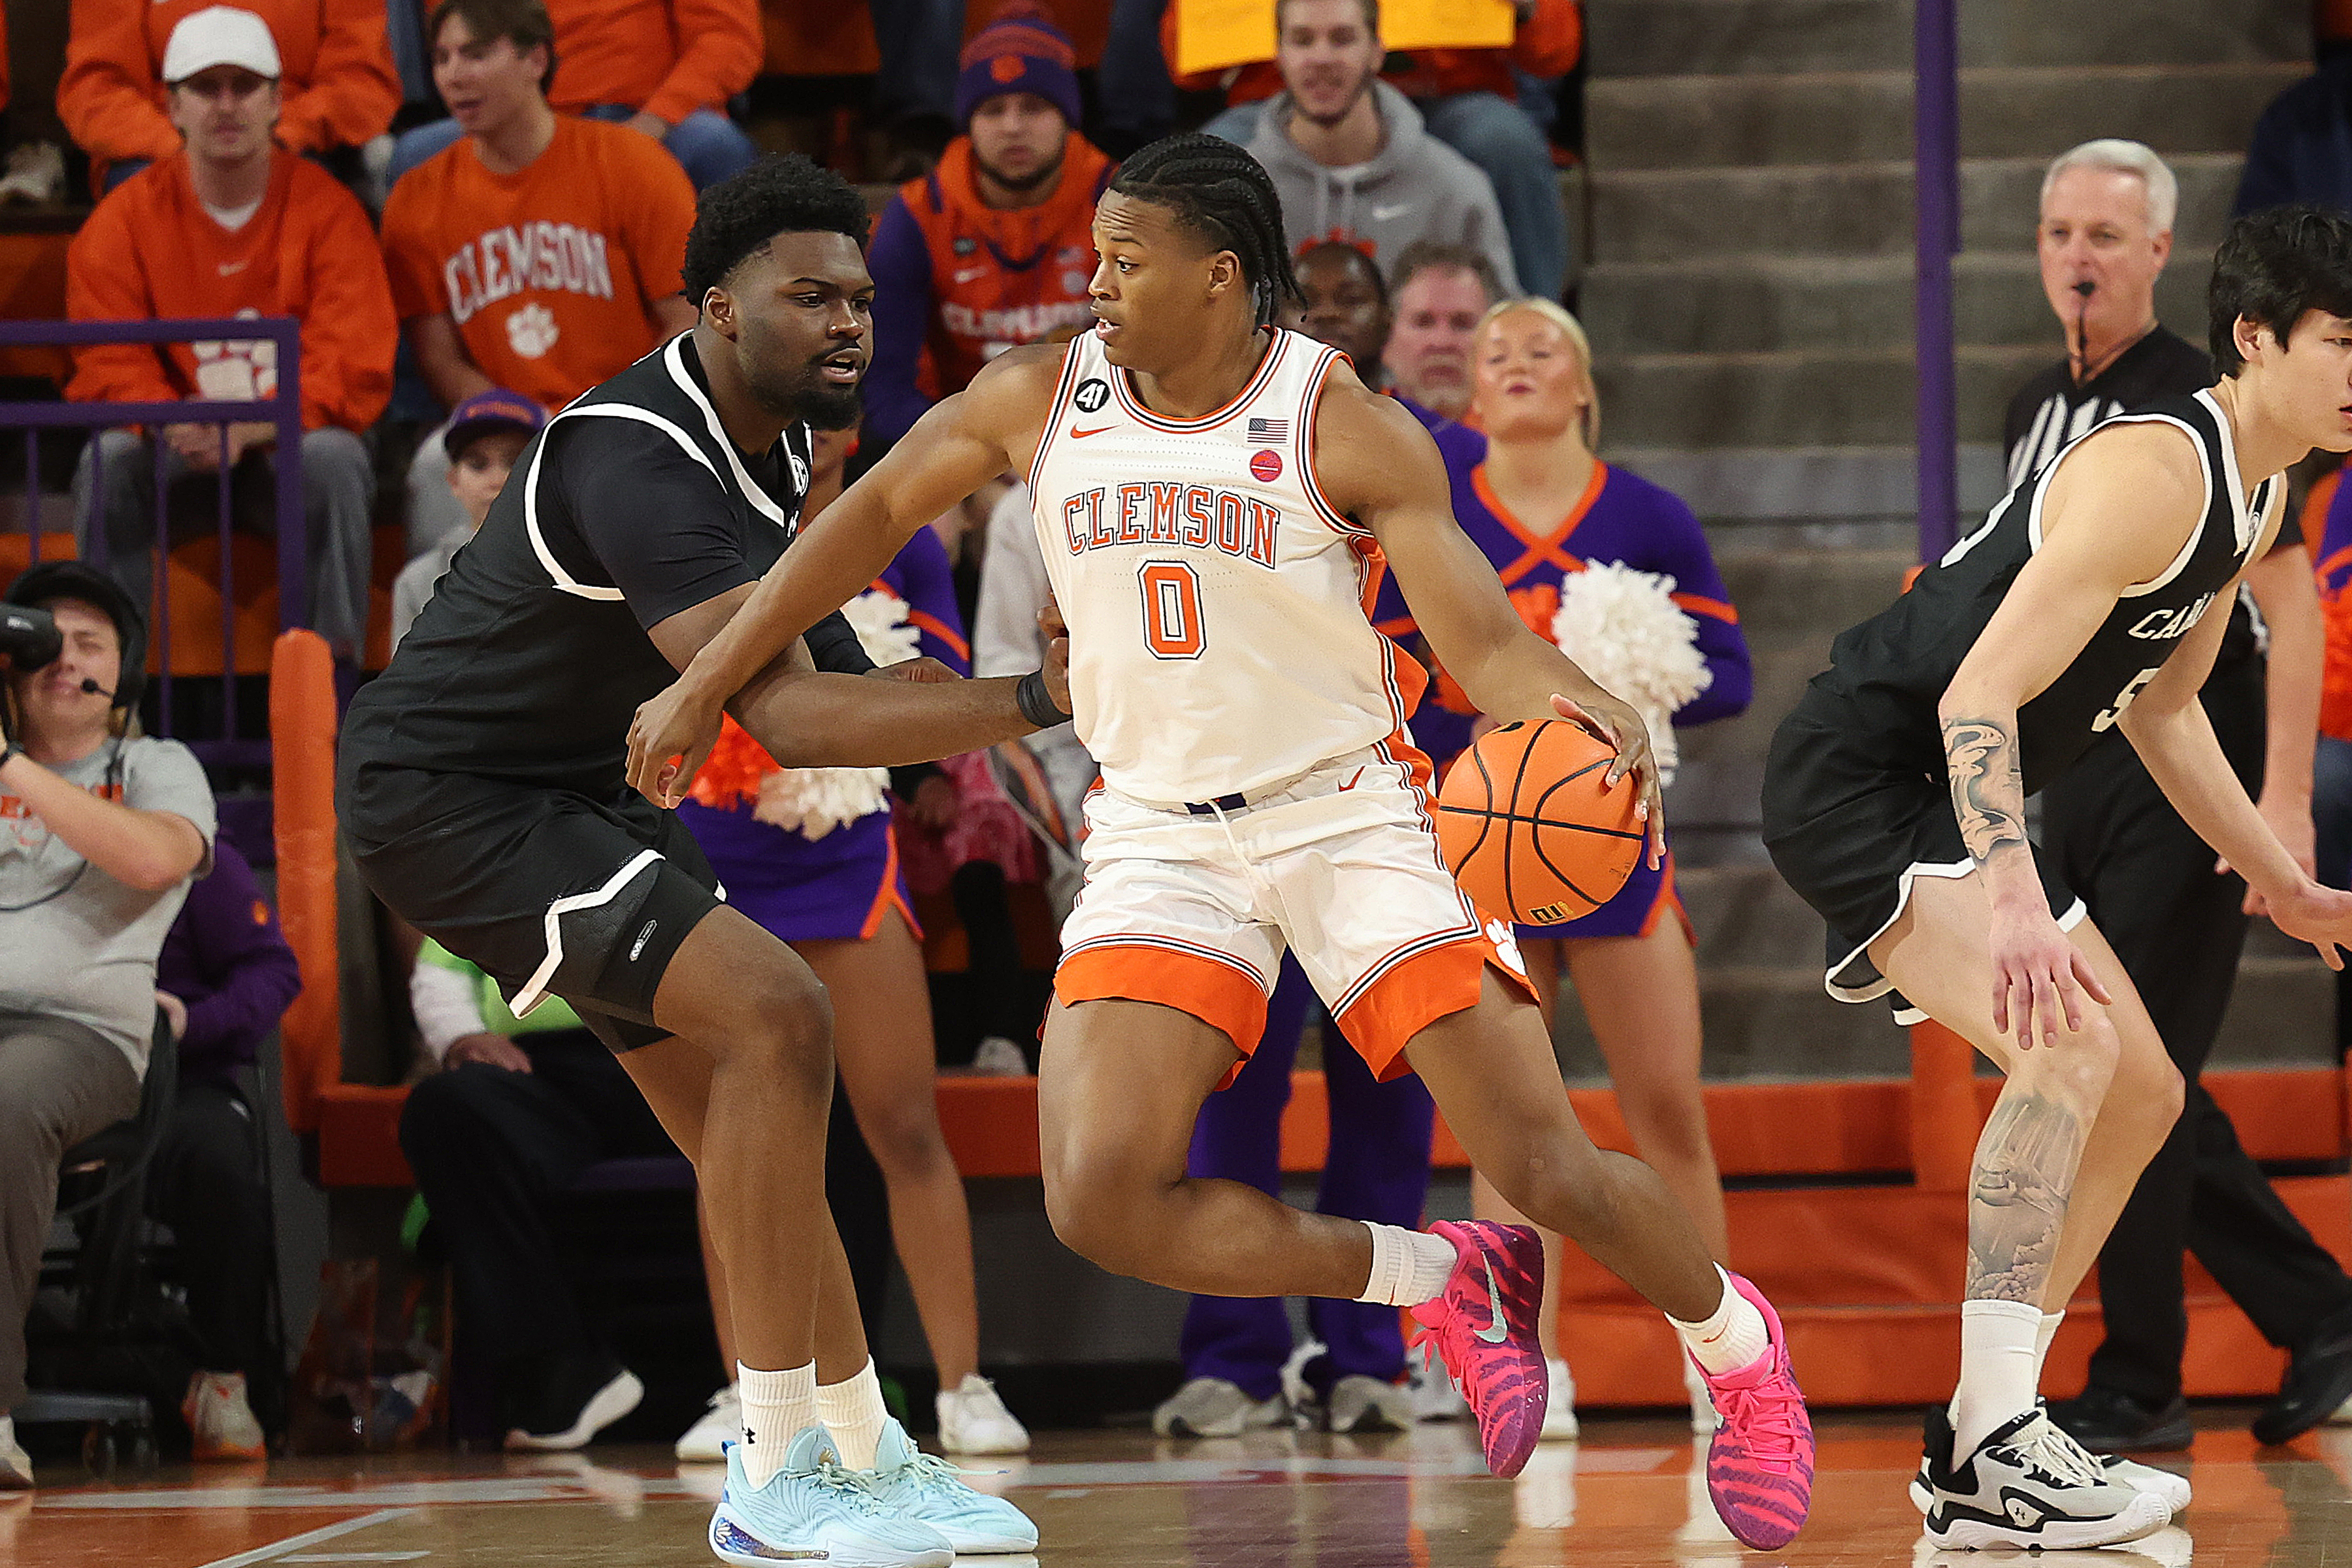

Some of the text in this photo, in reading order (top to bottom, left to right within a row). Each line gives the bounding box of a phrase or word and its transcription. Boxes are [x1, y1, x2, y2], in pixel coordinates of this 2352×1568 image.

[445, 220, 614, 324] CLEMSON
[1076, 383, 1106, 409] 41
[1061, 482, 1281, 570] CLEMSON
[1137, 560, 1207, 661] 0
